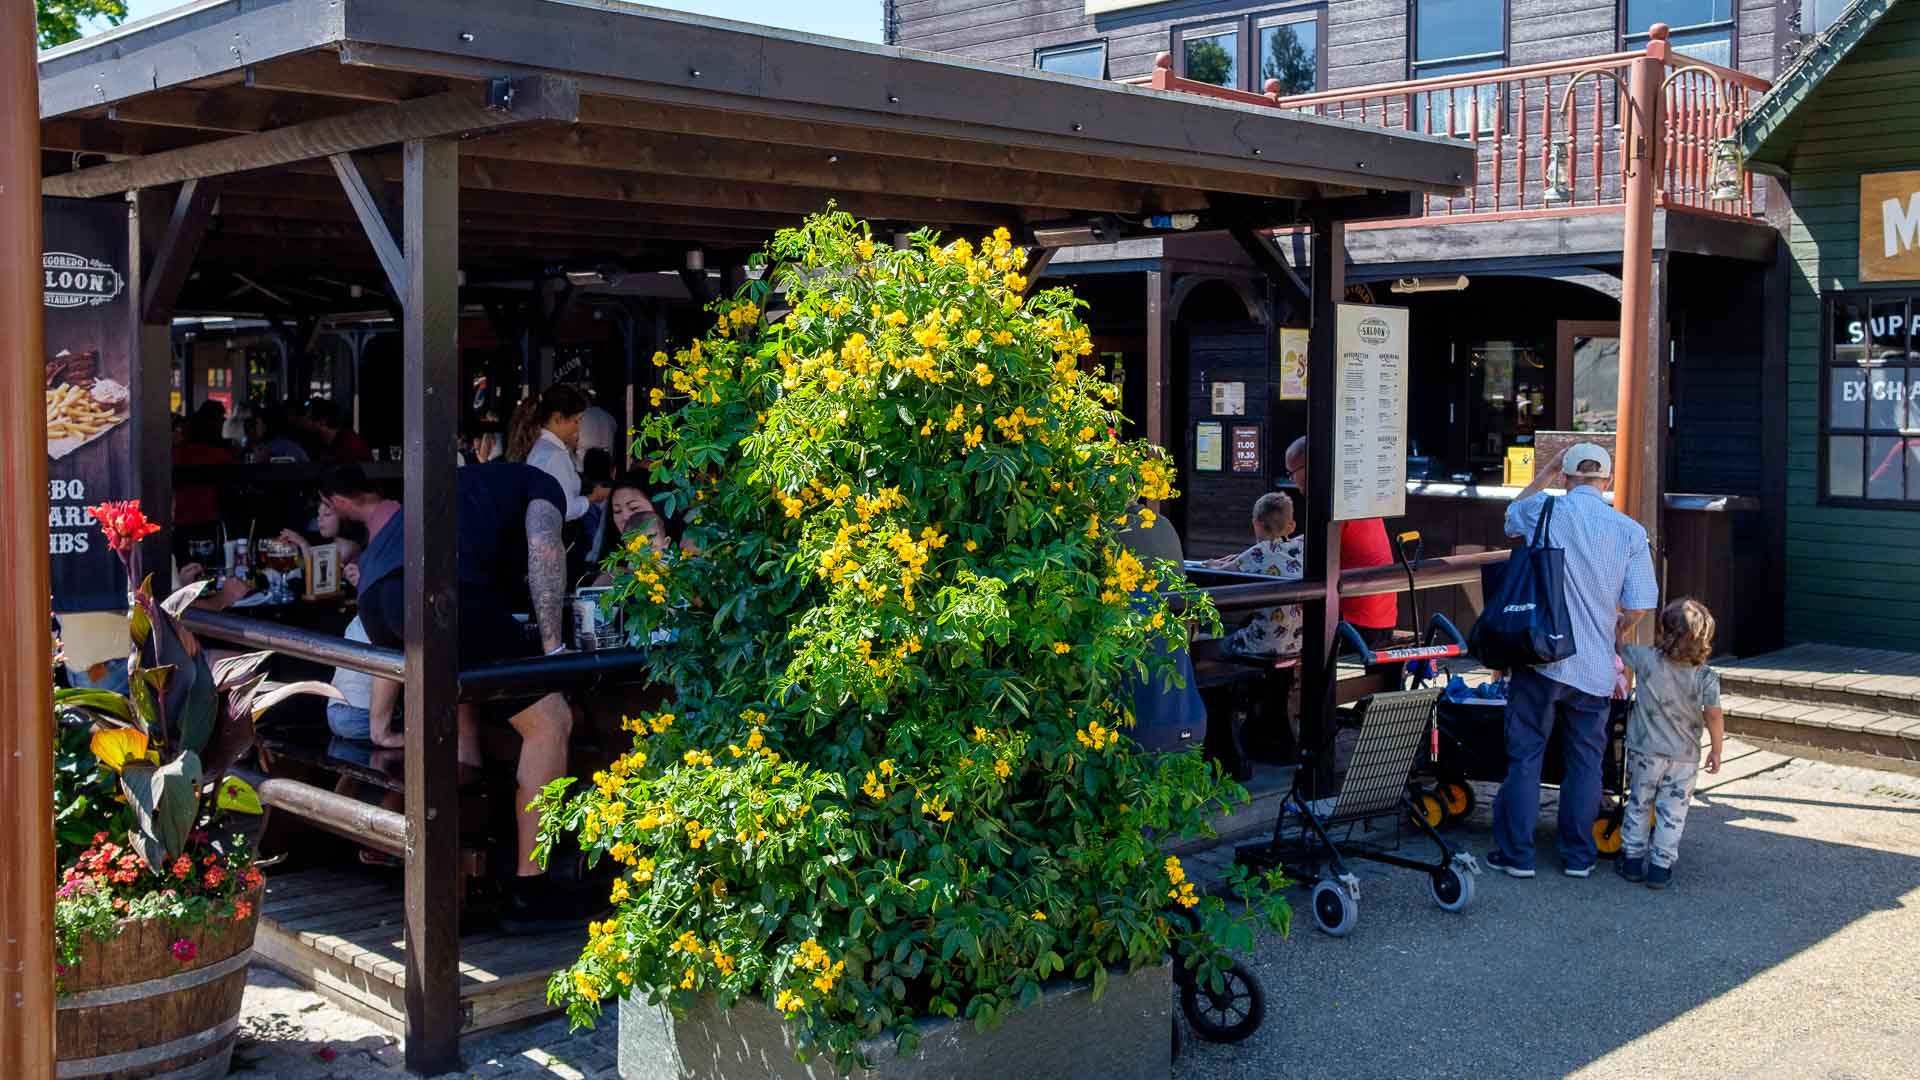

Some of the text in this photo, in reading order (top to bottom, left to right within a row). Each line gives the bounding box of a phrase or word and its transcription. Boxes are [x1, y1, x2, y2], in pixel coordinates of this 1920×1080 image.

[1882, 191, 1920, 257] M
[45, 271, 104, 291] LOON
[1362, 327, 1385, 337] SALOON
[48, 479, 84, 500] BQ
